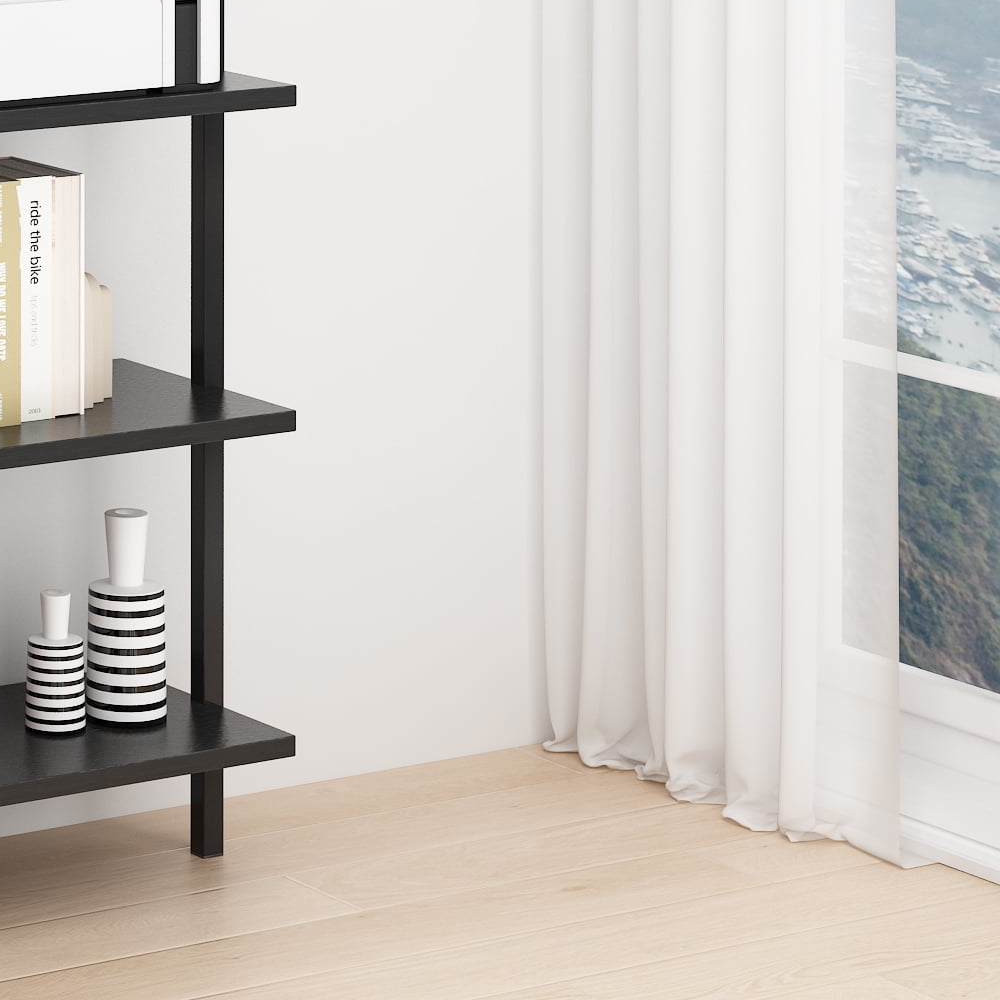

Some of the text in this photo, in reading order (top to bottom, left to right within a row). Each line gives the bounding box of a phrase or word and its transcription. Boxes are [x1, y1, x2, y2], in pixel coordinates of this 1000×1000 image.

[30, 200, 41, 285] ride the bike
